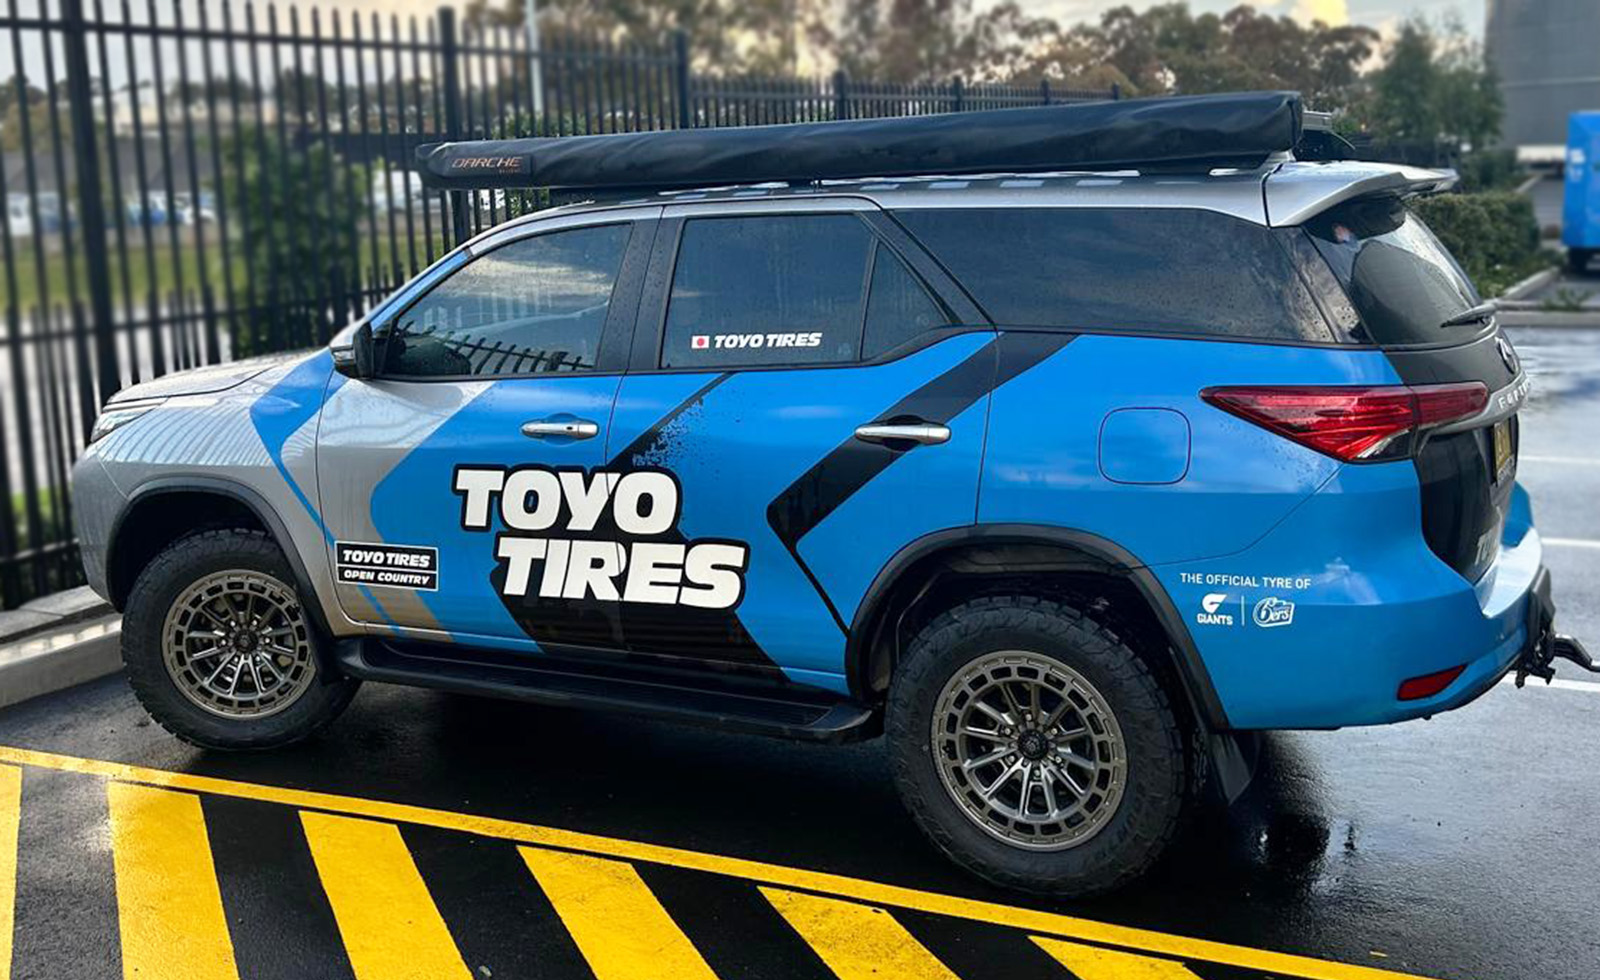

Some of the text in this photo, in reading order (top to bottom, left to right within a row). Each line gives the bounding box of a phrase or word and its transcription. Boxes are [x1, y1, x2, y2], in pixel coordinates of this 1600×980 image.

[452, 156, 522, 168] DARCHE
[714, 332, 823, 349] TOYO TIRES
[455, 469, 678, 534] TOYO
[343, 550, 431, 568] TOYO TIRES
[344, 570, 430, 585] OPEN COUNTRY
[497, 537, 746, 609] TIRES
[1180, 573, 1311, 589] THE OFFICIAL TYRE OF
[1197, 613, 1233, 625] GIANTS
